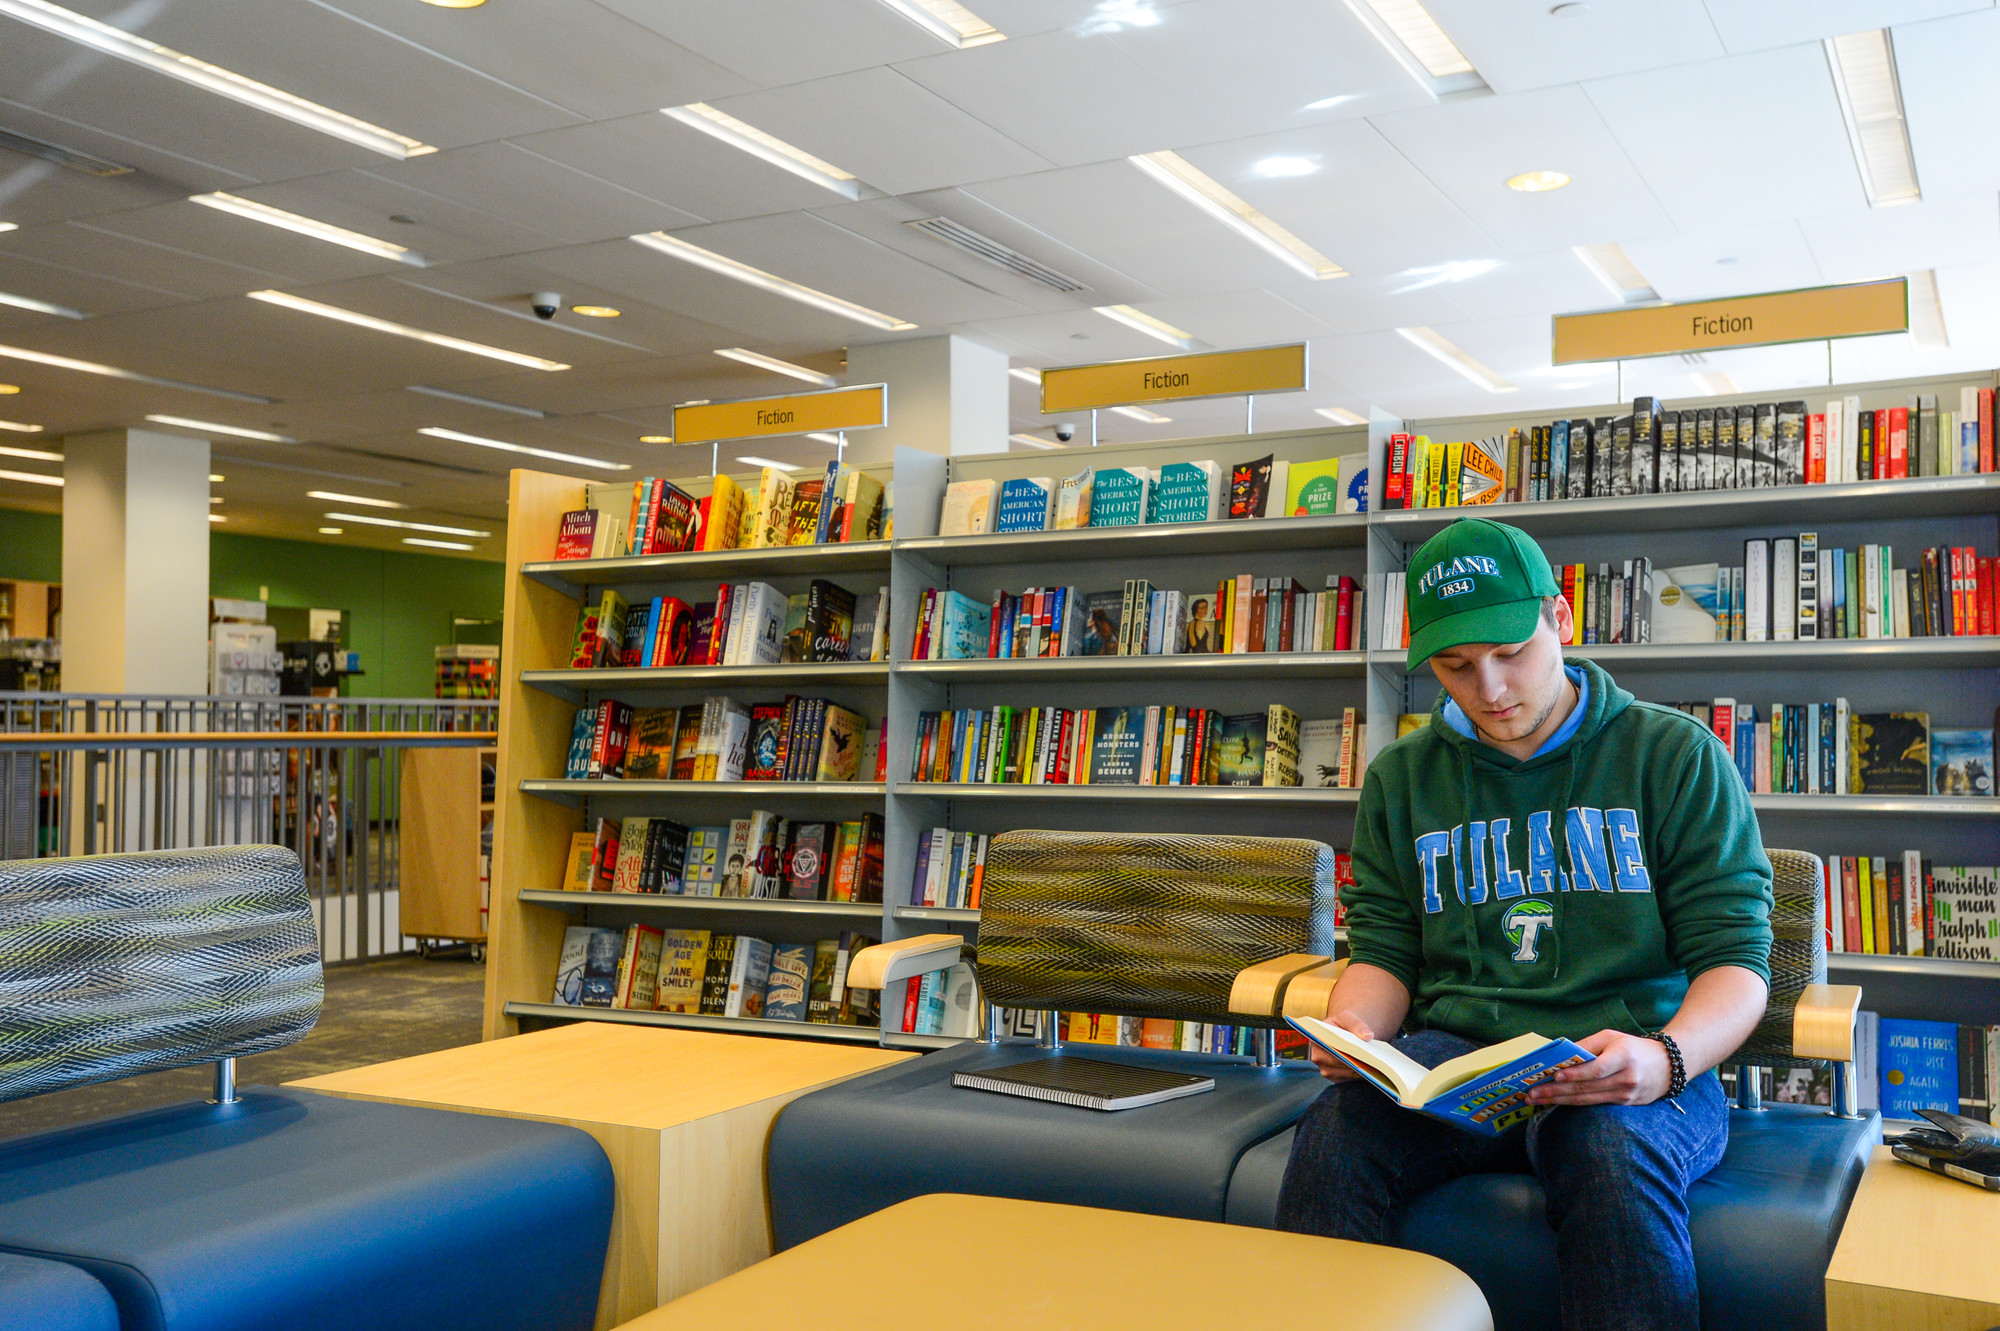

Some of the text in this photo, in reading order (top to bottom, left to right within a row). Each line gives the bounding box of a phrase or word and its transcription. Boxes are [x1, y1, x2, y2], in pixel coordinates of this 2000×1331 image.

[1693, 315, 1753, 336] Fiction
[1143, 370, 1190, 390] Fiction
[756, 408, 794, 426] Fiction
[1393, 439, 1405, 474] CHABON
[1466, 445, 1482, 469] LEE
[1484, 455, 1503, 482] CHILD
[1109, 477, 1141, 487] BEST
[1177, 472, 1208, 482] BEST
[1015, 487, 1046, 497] BEST
[1095, 490, 1139, 500] AMERICAN
[1161, 484, 1208, 495] AMERICAN
[1160, 496, 1209, 511] SHORT
[1308, 492, 1332, 503] PRIZE
[1001, 500, 1045, 510] AMERICAN
[1093, 500, 1140, 515] SHORT
[565, 511, 591, 524] Mitch
[793, 516, 817, 530] THE
[1000, 511, 1045, 524] SHORT
[1091, 516, 1137, 527] STORIES
[1159, 511, 1205, 523] STORIES
[561, 525, 591, 536] Albom
[567, 547, 588, 556] strings
[1418, 556, 1499, 596] TULANE
[1442, 580, 1468, 596] 1834
[753, 707, 781, 719] STEPHEN
[1047, 711, 1061, 772] LITTLE MAN
[1867, 767, 1922, 775] FROG MUSIC
[1414, 806, 1651, 914] TULANE
[1932, 875, 1998, 896] invisible
[1956, 899, 1996, 913] man
[1939, 917, 1986, 943] ralph
[667, 938, 702, 950] GOLDEN
[1937, 940, 1991, 960] ellison
[562, 944, 584, 964] good
[674, 951, 692, 960] AGE
[668, 967, 692, 977] JANE
[662, 978, 695, 988] SMILEY
[714, 987, 725, 995] OF
[1889, 1036, 1953, 1051] JOSHUA FERRIS
[1896, 1054, 1944, 1069] TO RISE
[1462, 1064, 1541, 1099] CRISTINA ALGER
[1910, 1076, 1939, 1088] AGAIN
[1458, 1085, 1511, 1112] THIS
[1479, 1094, 1520, 1118] NOT
[1893, 1100, 1948, 1112] DECENT HOUR
